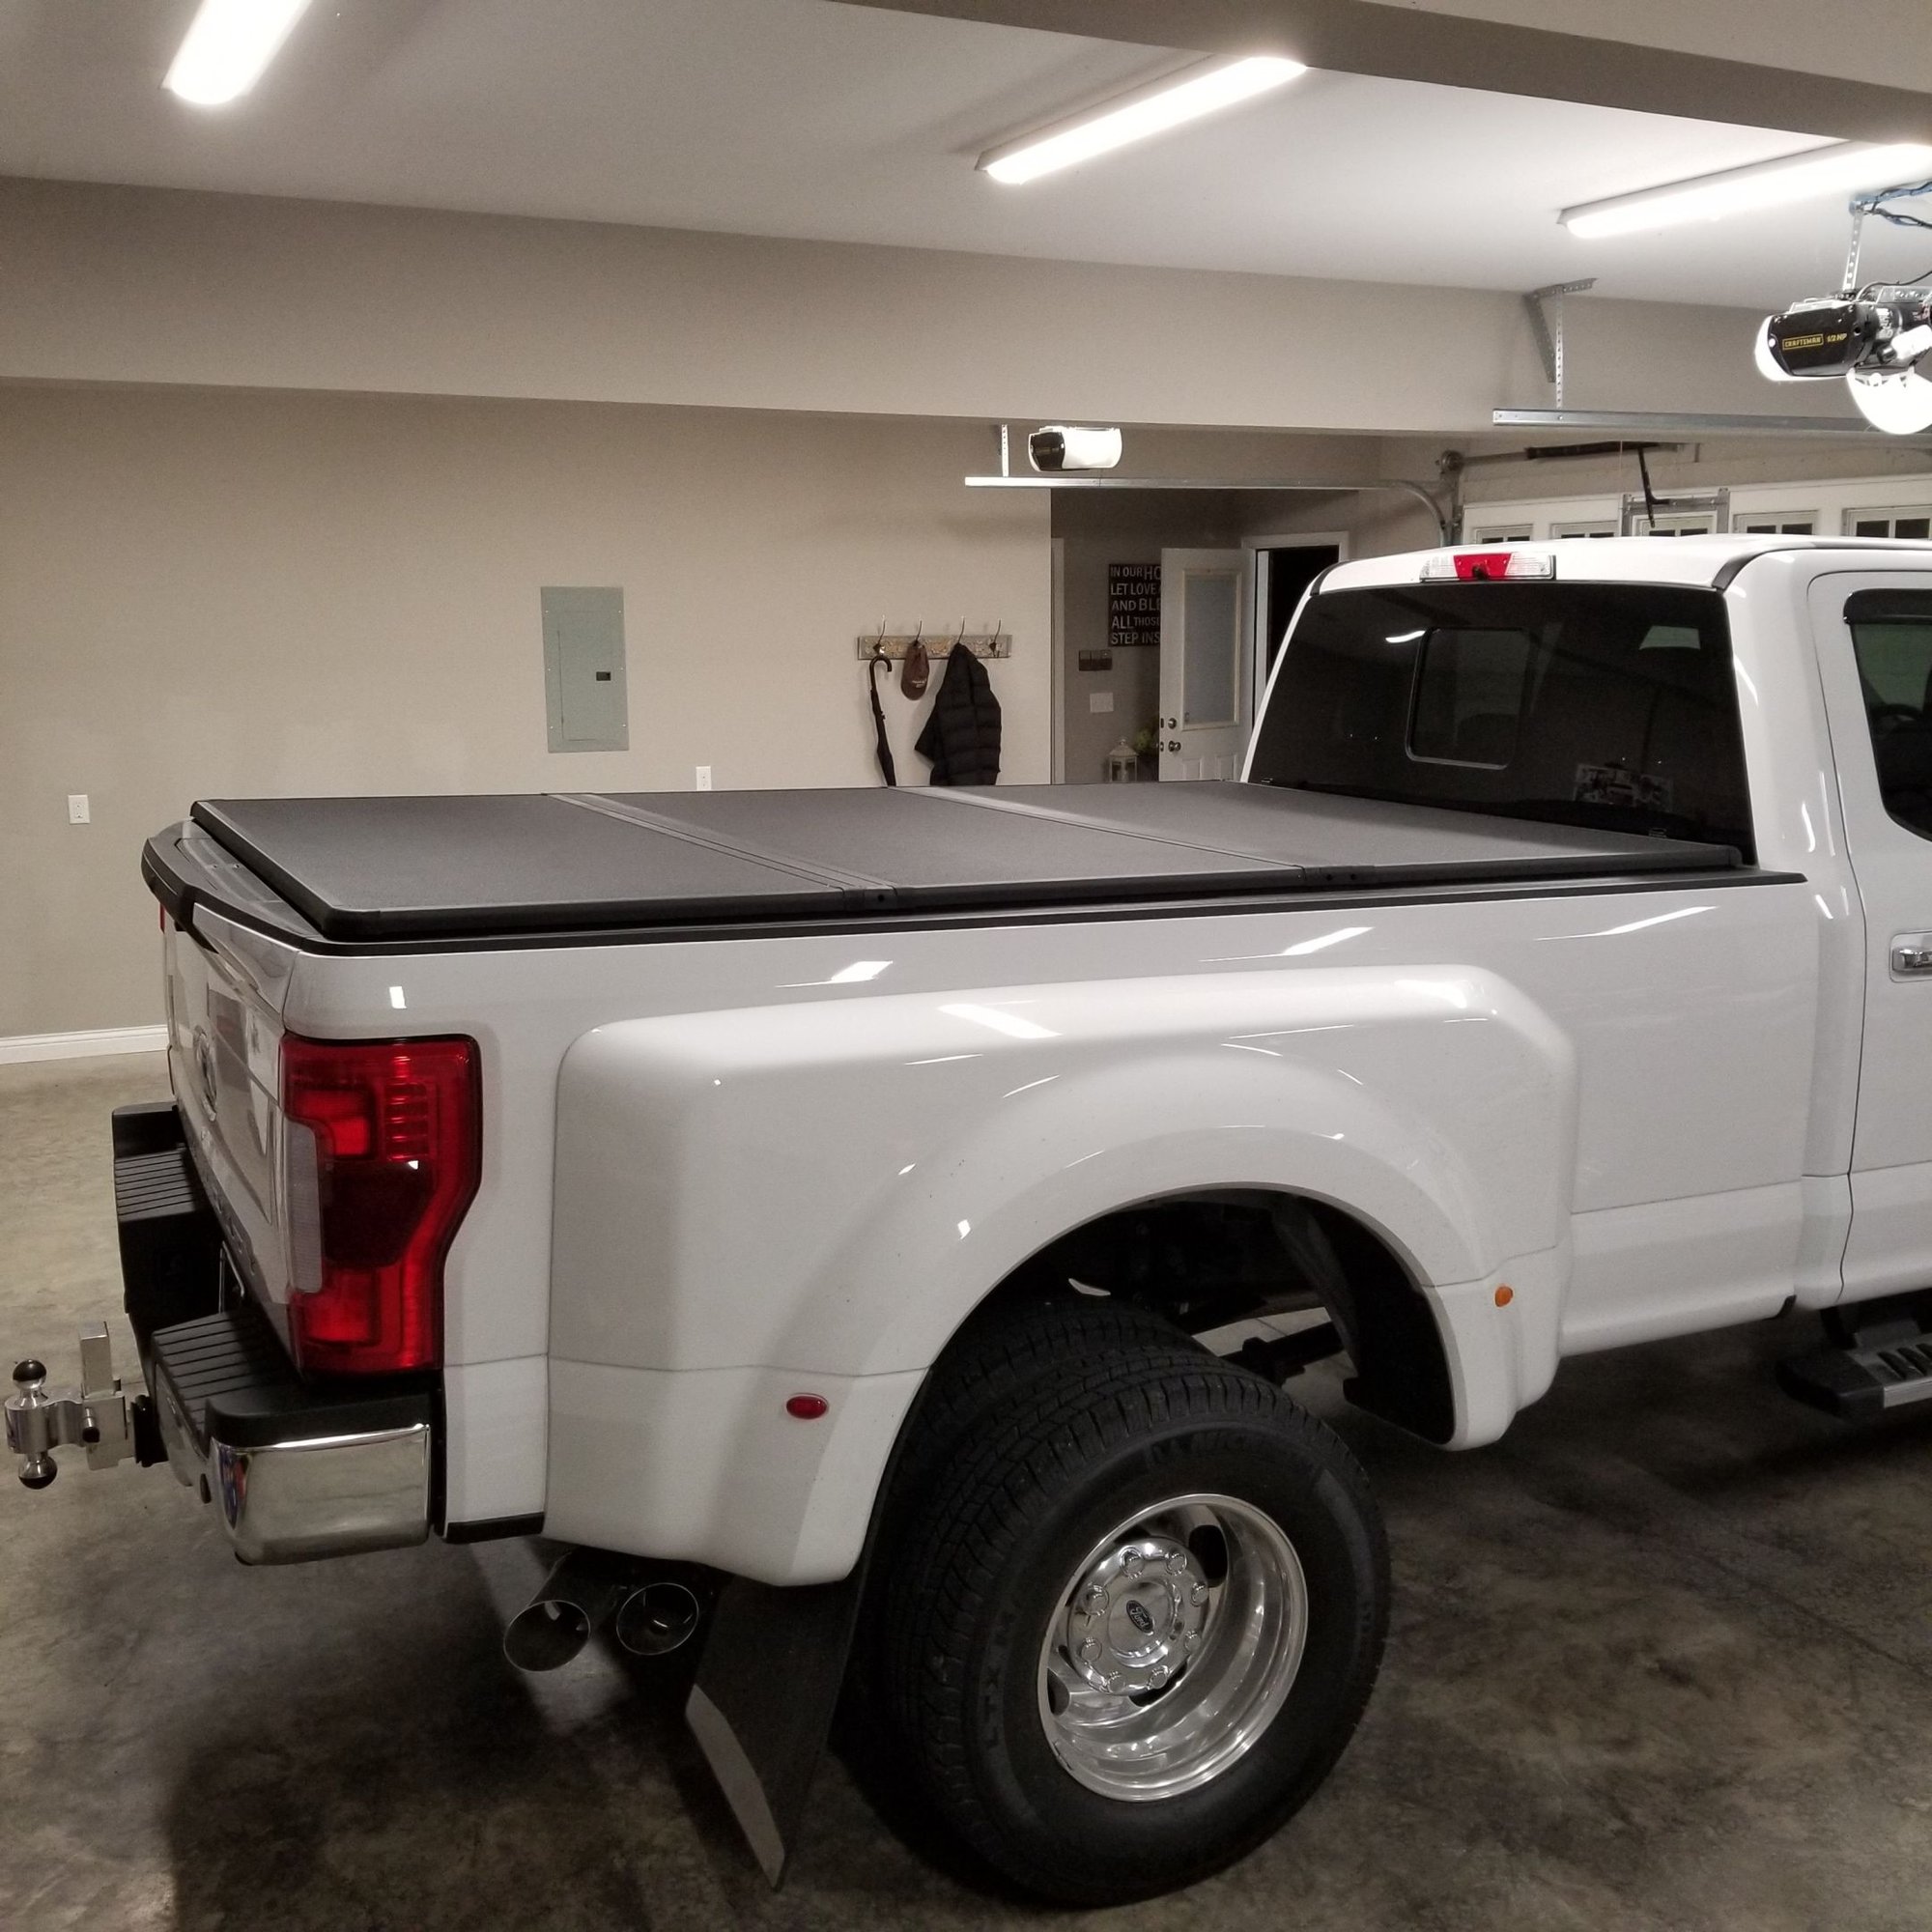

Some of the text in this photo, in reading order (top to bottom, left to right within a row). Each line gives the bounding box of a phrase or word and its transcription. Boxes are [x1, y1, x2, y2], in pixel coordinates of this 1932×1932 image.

[1784, 336, 1822, 348] CRAFTSMAN
[1111, 566, 1121, 577] IN
[1122, 566, 1143, 578] OUR
[1110, 582, 1128, 596] LET
[1130, 582, 1156, 595] LOVE
[1112, 599, 1137, 611] AND
[1111, 615, 1134, 629] ALL
[1111, 632, 1139, 645] STEP
[1129, 1606, 1150, 1628] Ford
